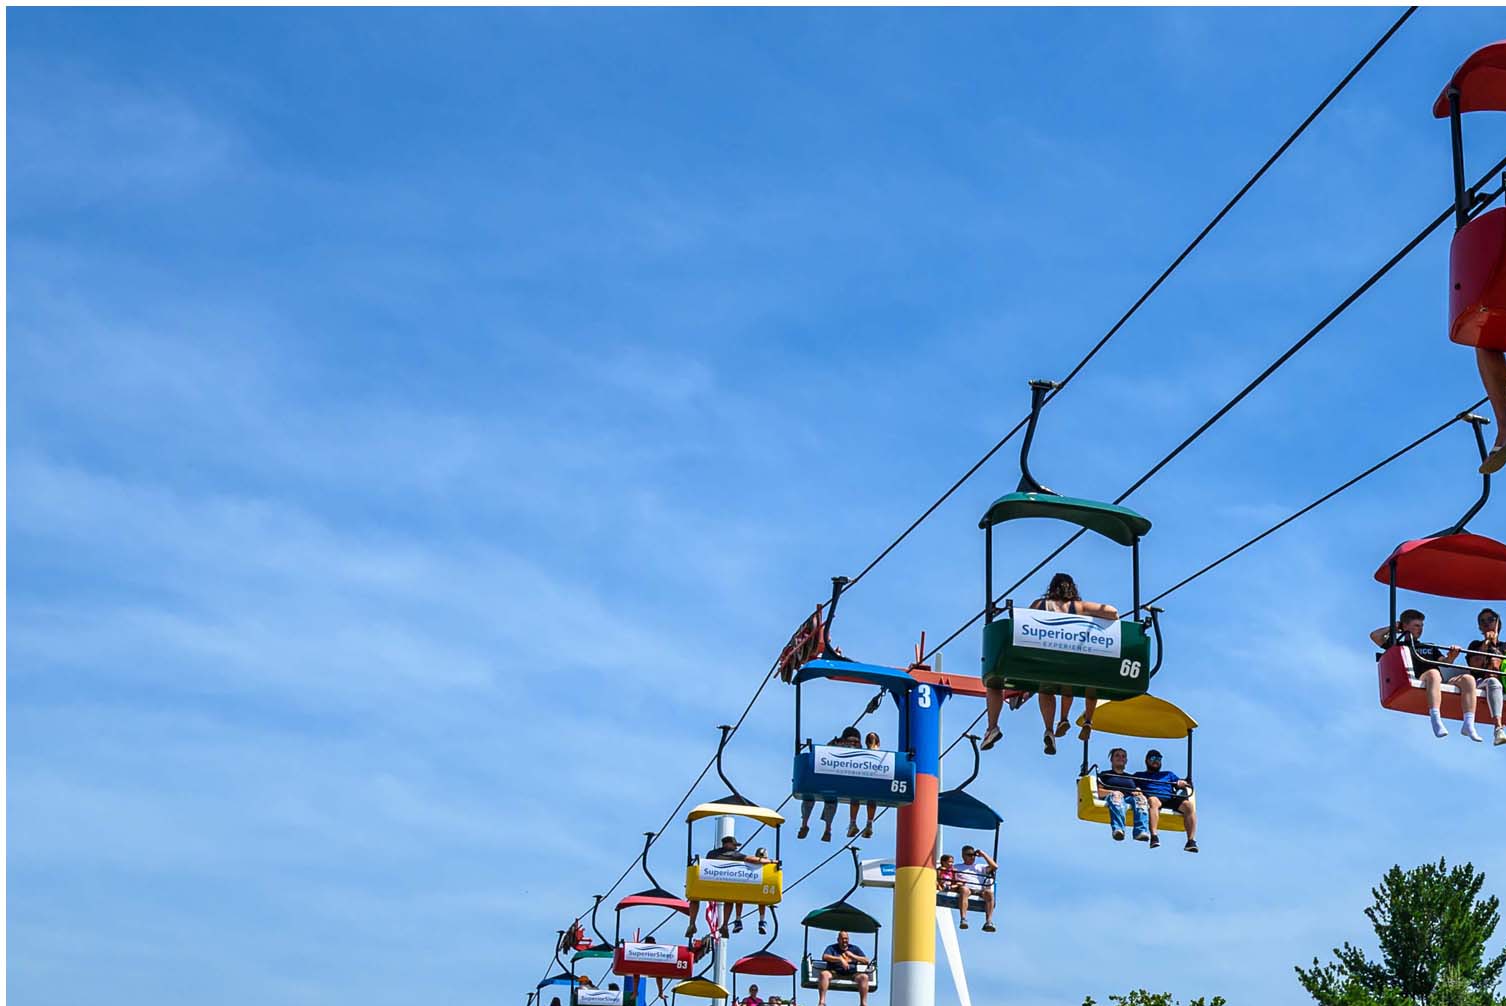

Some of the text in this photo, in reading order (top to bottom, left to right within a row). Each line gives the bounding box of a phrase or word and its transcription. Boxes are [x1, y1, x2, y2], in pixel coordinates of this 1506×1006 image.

[1022, 624, 1114, 648] SuperiorSleep
[1042, 641, 1093, 653] EXPERIENCE
[1120, 659, 1141, 678] 66
[918, 684, 931, 708] 3
[820, 757, 890, 773] SuperiorSleep
[891, 780, 907, 793] 65
[703, 868, 759, 879] SuperiorSleep
[762, 885, 775, 895] 64
[677, 961, 688, 969] 63
